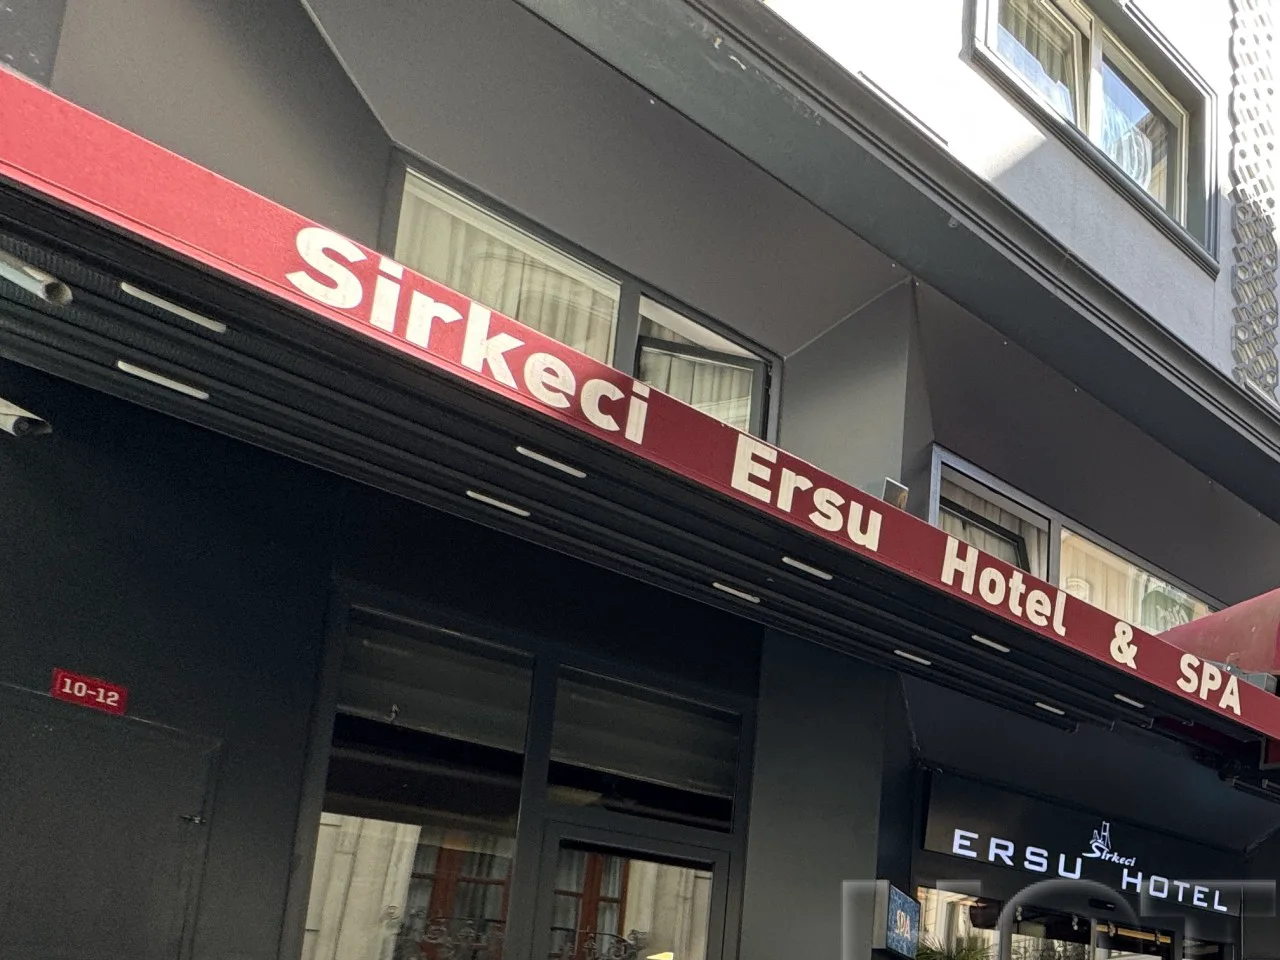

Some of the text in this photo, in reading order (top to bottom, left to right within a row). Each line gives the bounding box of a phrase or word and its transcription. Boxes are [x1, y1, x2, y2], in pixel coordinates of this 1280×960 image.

[286, 225, 1241, 715] Sirkeci Ersu Hotel & SPA
[62, 678, 119, 706] 10-12
[1082, 840, 1136, 867] Sirkeci
[952, 828, 1228, 912] ERSU HOTEL
[894, 909, 911, 941] SPA
